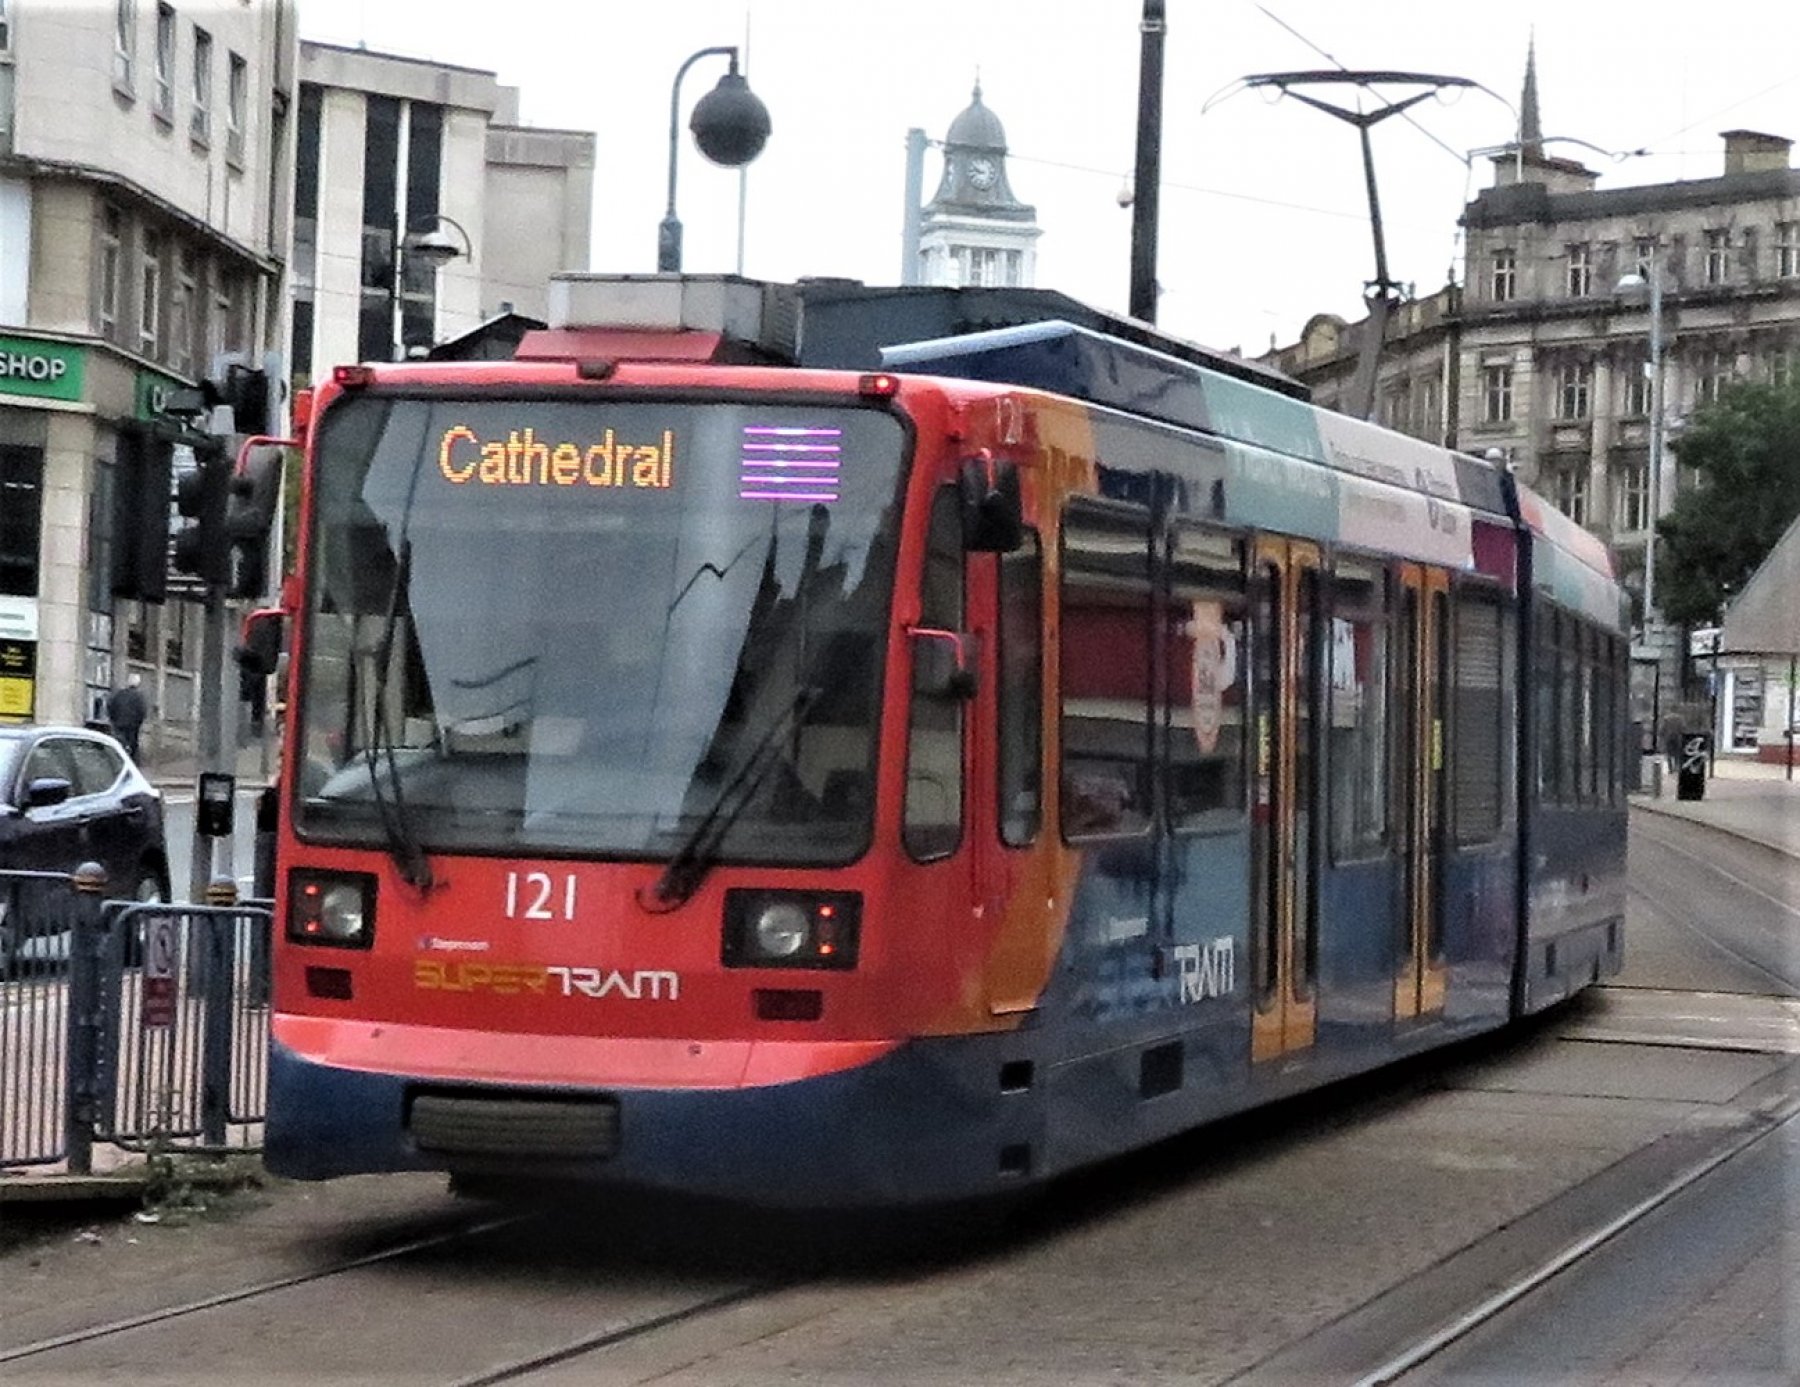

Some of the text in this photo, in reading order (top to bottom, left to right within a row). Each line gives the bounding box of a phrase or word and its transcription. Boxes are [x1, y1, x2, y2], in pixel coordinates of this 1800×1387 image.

[0, 351, 67, 381] SHOP
[439, 424, 673, 488] Cathedral
[505, 871, 577, 921] 121
[1174, 934, 1234, 1006] TRAM
